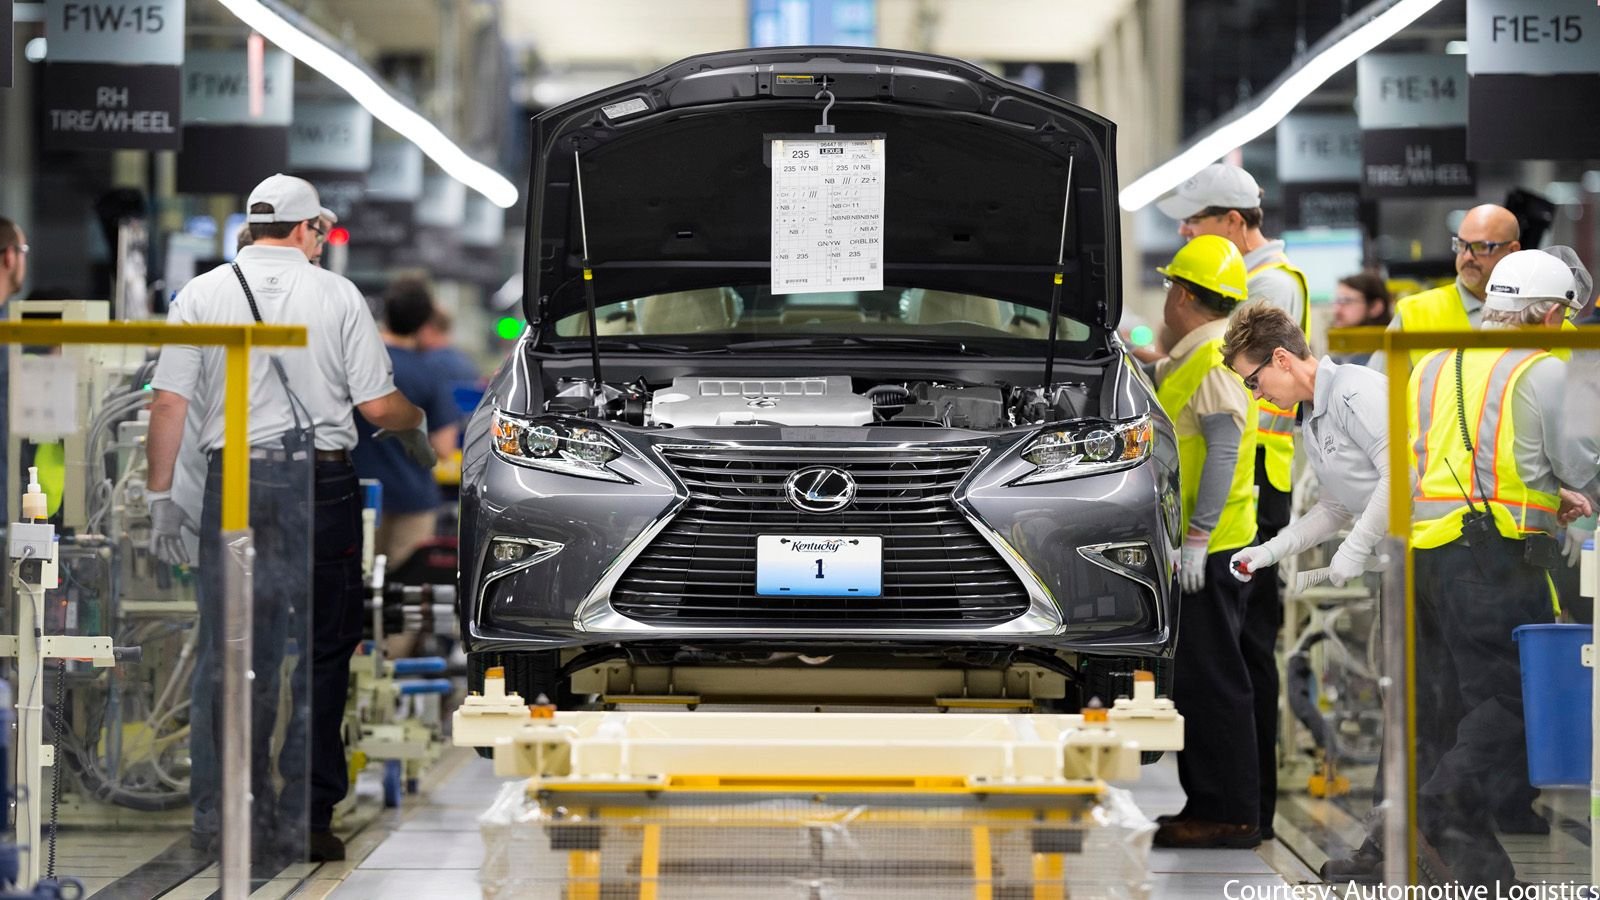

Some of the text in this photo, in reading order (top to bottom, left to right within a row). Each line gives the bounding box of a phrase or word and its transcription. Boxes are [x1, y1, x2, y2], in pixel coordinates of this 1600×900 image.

[63, 4, 164, 33] F1W-15
[1492, 16, 1582, 43] F1E-15
[96, 86, 128, 108] RH
[1381, 76, 1456, 100] F1E-14
[50, 109, 175, 133] TIRE/WHEEL
[792, 150, 810, 159] 235
[791, 541, 840, 553] Kentucky
[815, 559, 825, 579] 1
